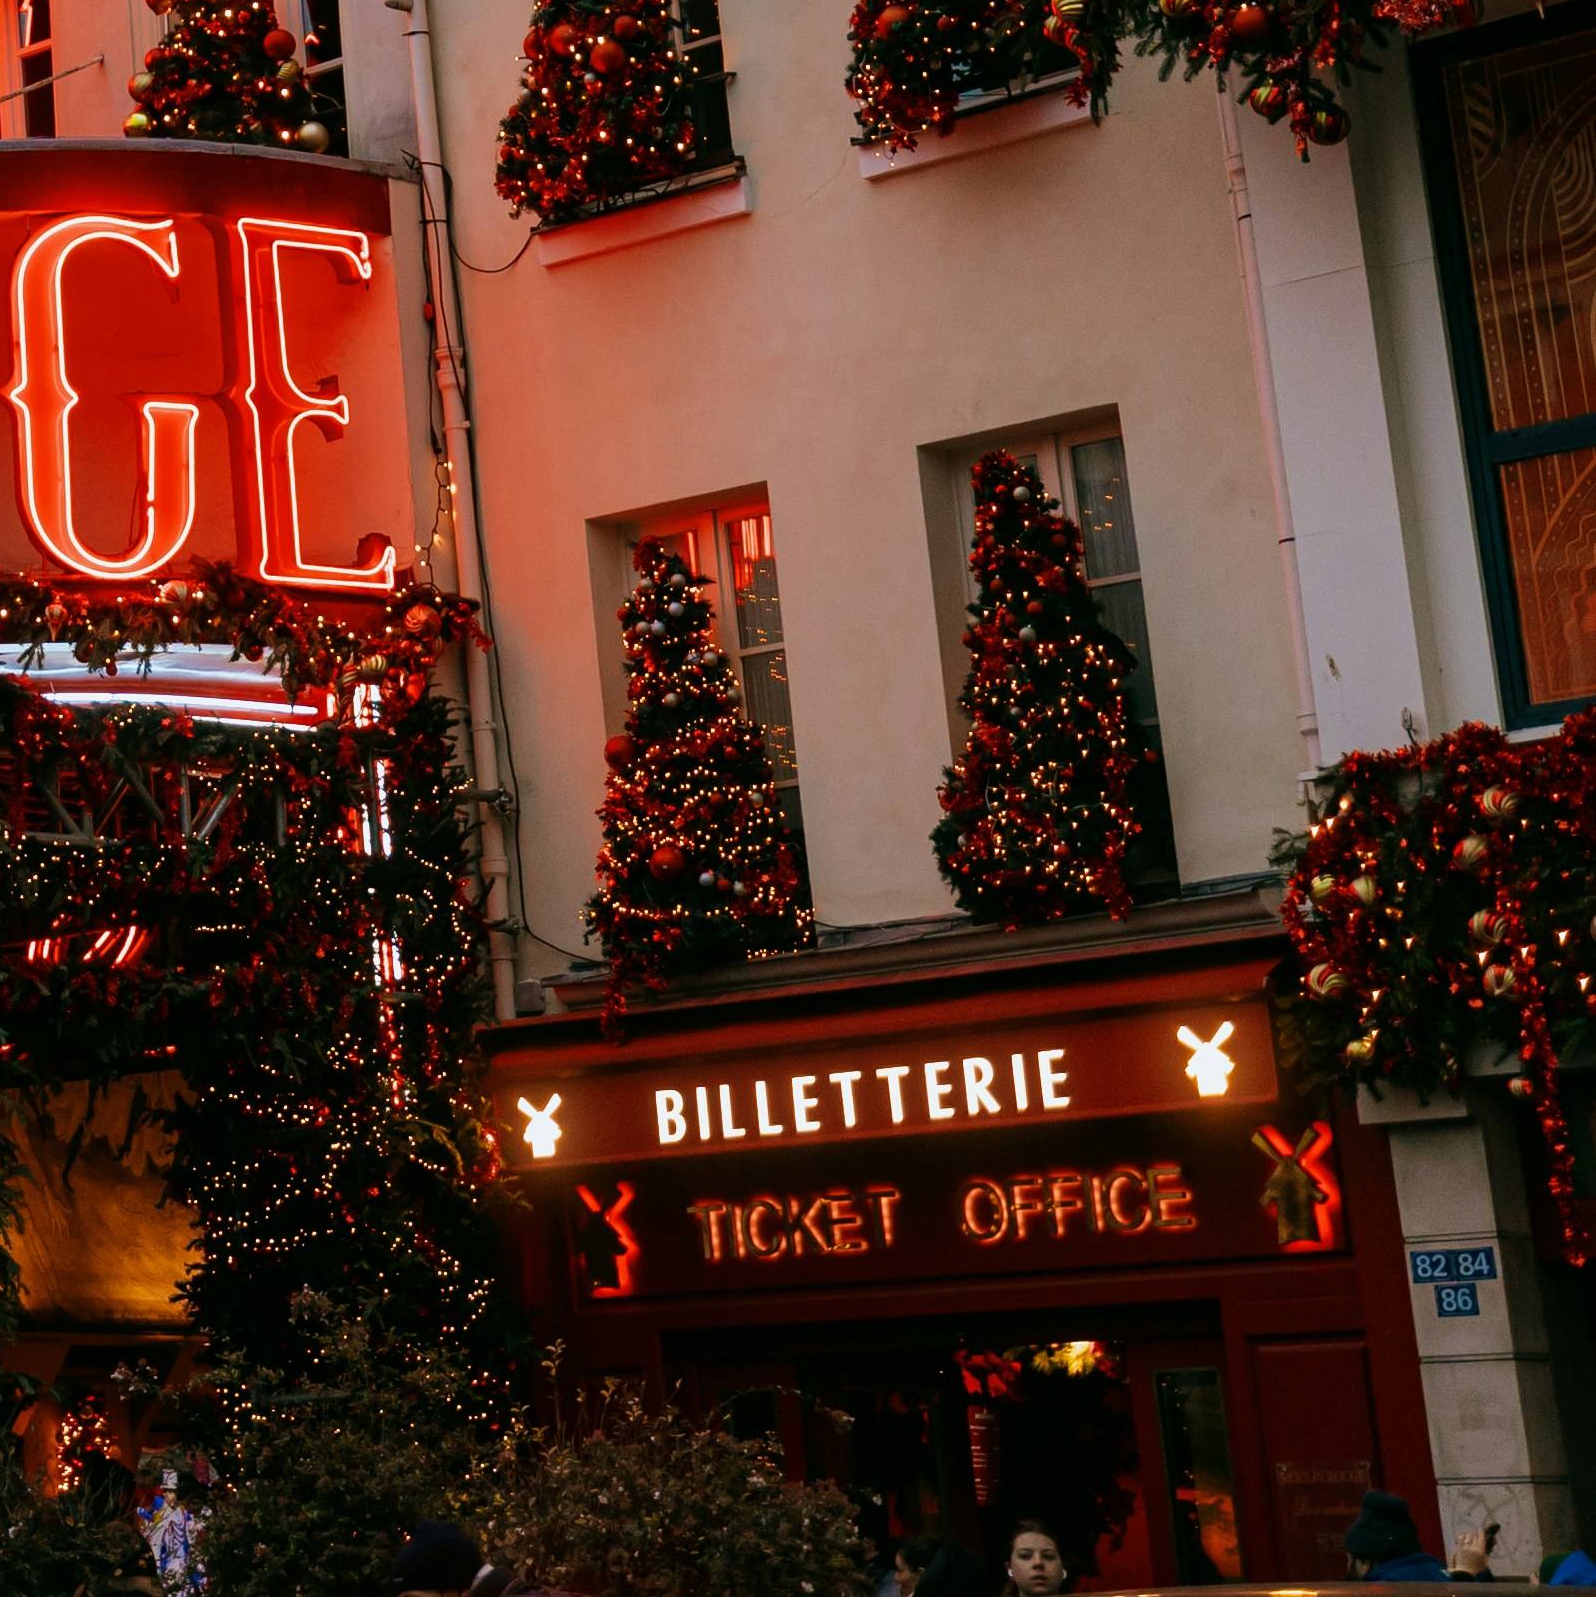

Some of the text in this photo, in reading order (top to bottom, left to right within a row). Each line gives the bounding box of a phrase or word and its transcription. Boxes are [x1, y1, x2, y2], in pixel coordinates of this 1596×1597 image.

[653, 1047, 1073, 1146] BILLETTERIE
[687, 1165, 1195, 1263] TICKET OFFICE
[1416, 1251, 1490, 1278] 82 84
[1440, 1287, 1473, 1312] 86
